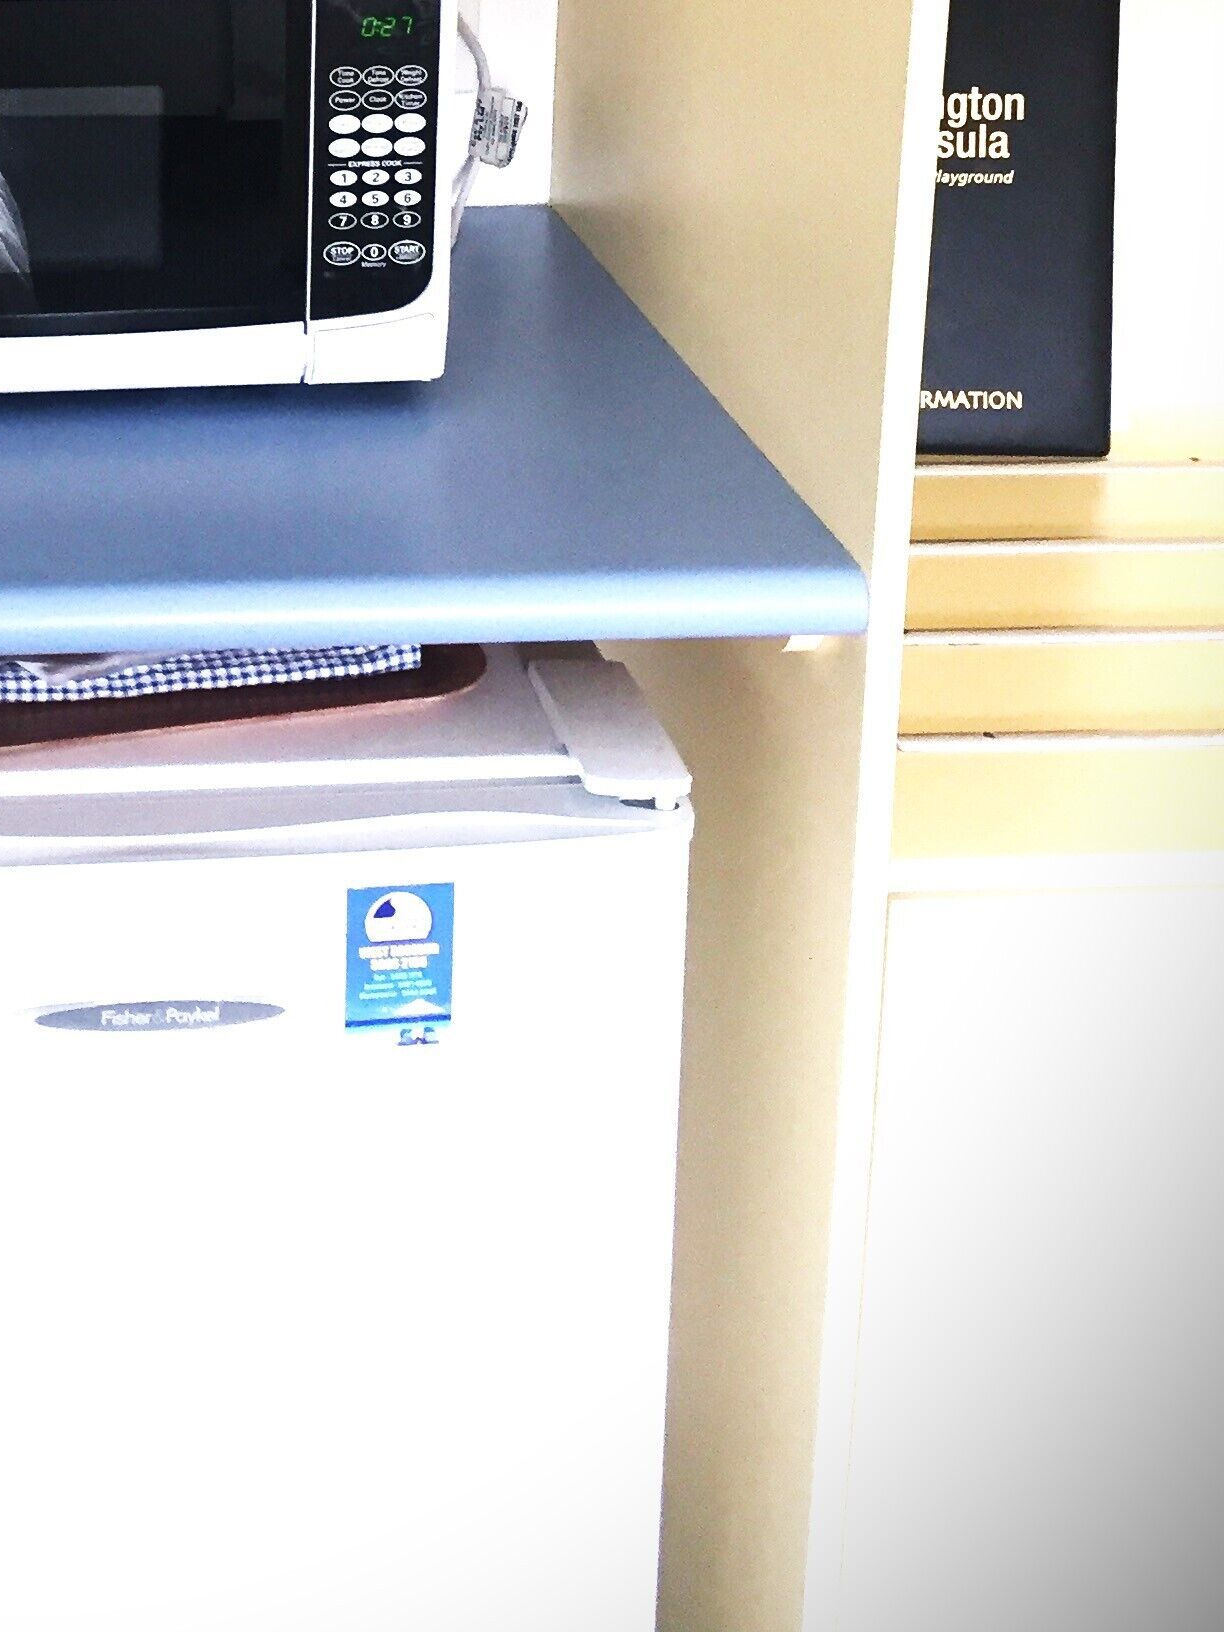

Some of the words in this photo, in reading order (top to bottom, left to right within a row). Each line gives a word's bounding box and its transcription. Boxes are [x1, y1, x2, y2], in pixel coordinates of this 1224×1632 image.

[361, 16, 413, 37] 0:27
[335, 96, 356, 104] Power
[368, 95, 388, 103] Clock
[937, 123, 1011, 159] sula
[348, 160, 381, 168] EXPRESS
[381, 159, 403, 167] COOK
[342, 173, 347, 184] 1
[372, 172, 380, 183] 2
[404, 171, 412, 182] 3
[935, 169, 1015, 187] layground
[339, 194, 347, 205] 4
[371, 193, 379, 204] 5
[403, 192, 412, 204] 6
[339, 215, 348, 227] 7
[370, 214, 380, 226] 8
[402, 214, 412, 226] 9
[330, 246, 355, 255] STOP
[370, 246, 379, 258] 0
[393, 245, 420, 254] START
[920, 390, 1023, 410] RMATION
[101, 1009, 152, 1026] Fisher
[166, 1006, 220, 1024] Paykel
